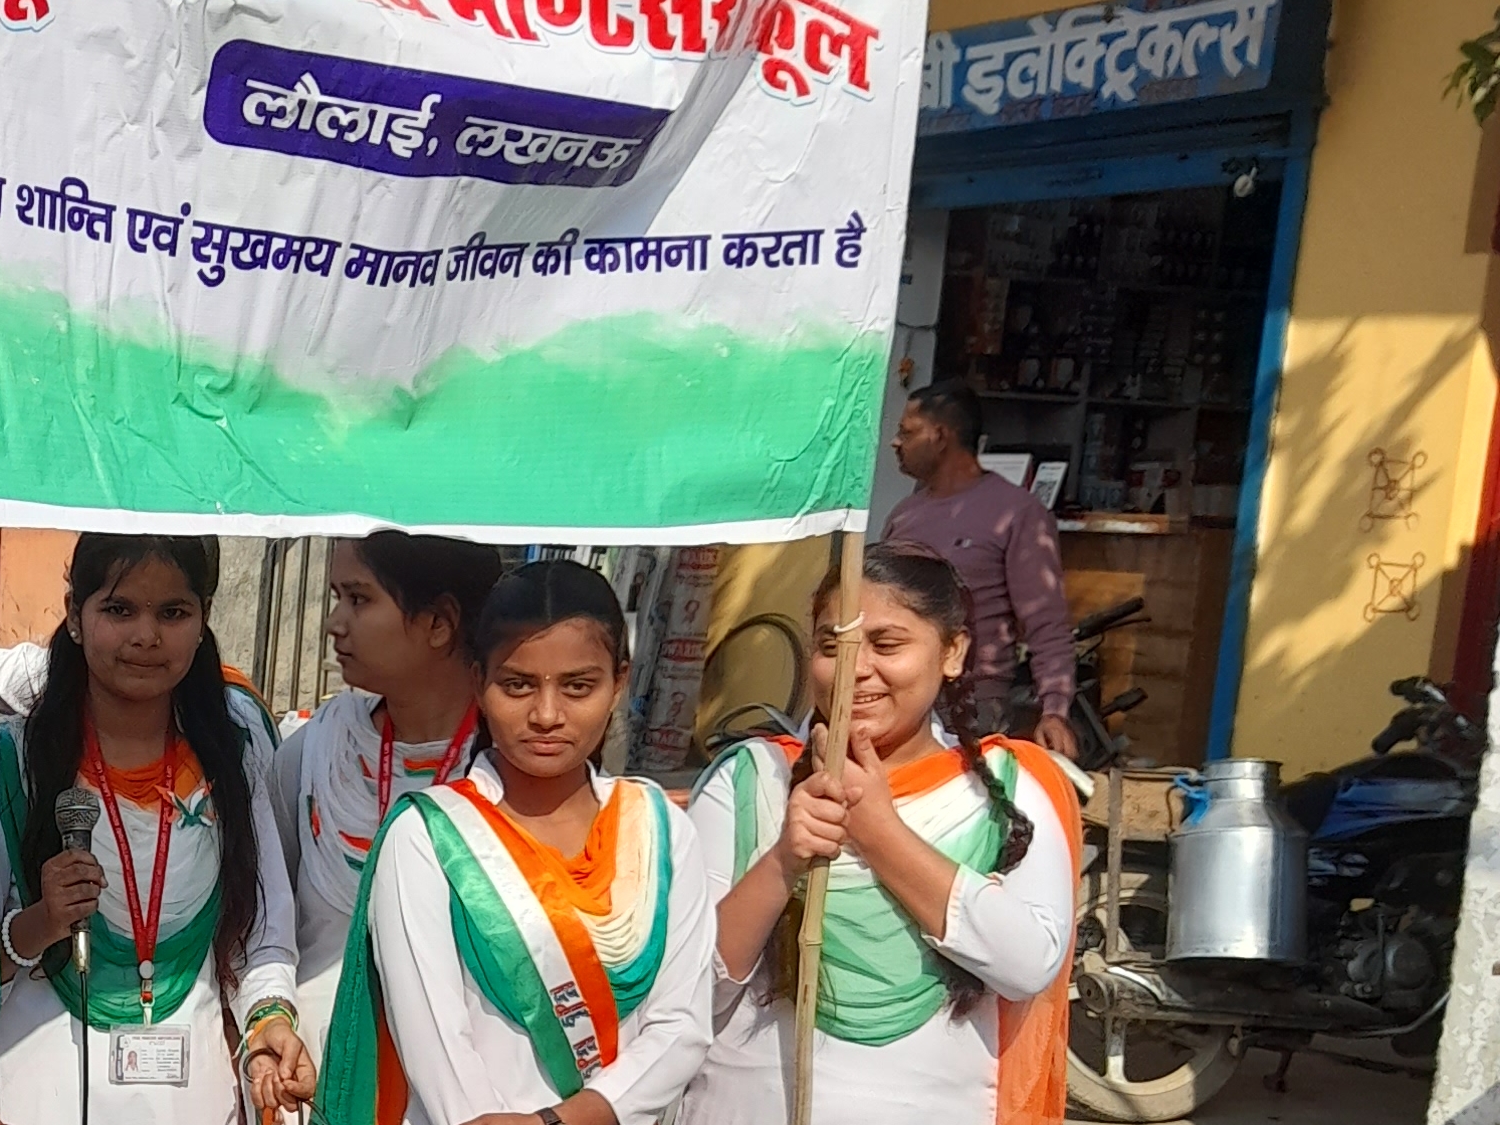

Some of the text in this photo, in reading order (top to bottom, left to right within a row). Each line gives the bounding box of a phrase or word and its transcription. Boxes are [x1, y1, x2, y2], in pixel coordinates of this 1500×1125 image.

[242, 72, 642, 170] लौलाई, लखनऊ
[15, 177, 117, 243] शान्ति
[126, 202, 191, 257] एवं
[190, 220, 342, 288] सुखमय
[344, 243, 444, 288] मानव
[445, 231, 529, 282] जीवन
[531, 227, 579, 277] की
[583, 234, 712, 274] कामना
[721, 229, 825, 269] करता
[834, 209, 867, 268] है
